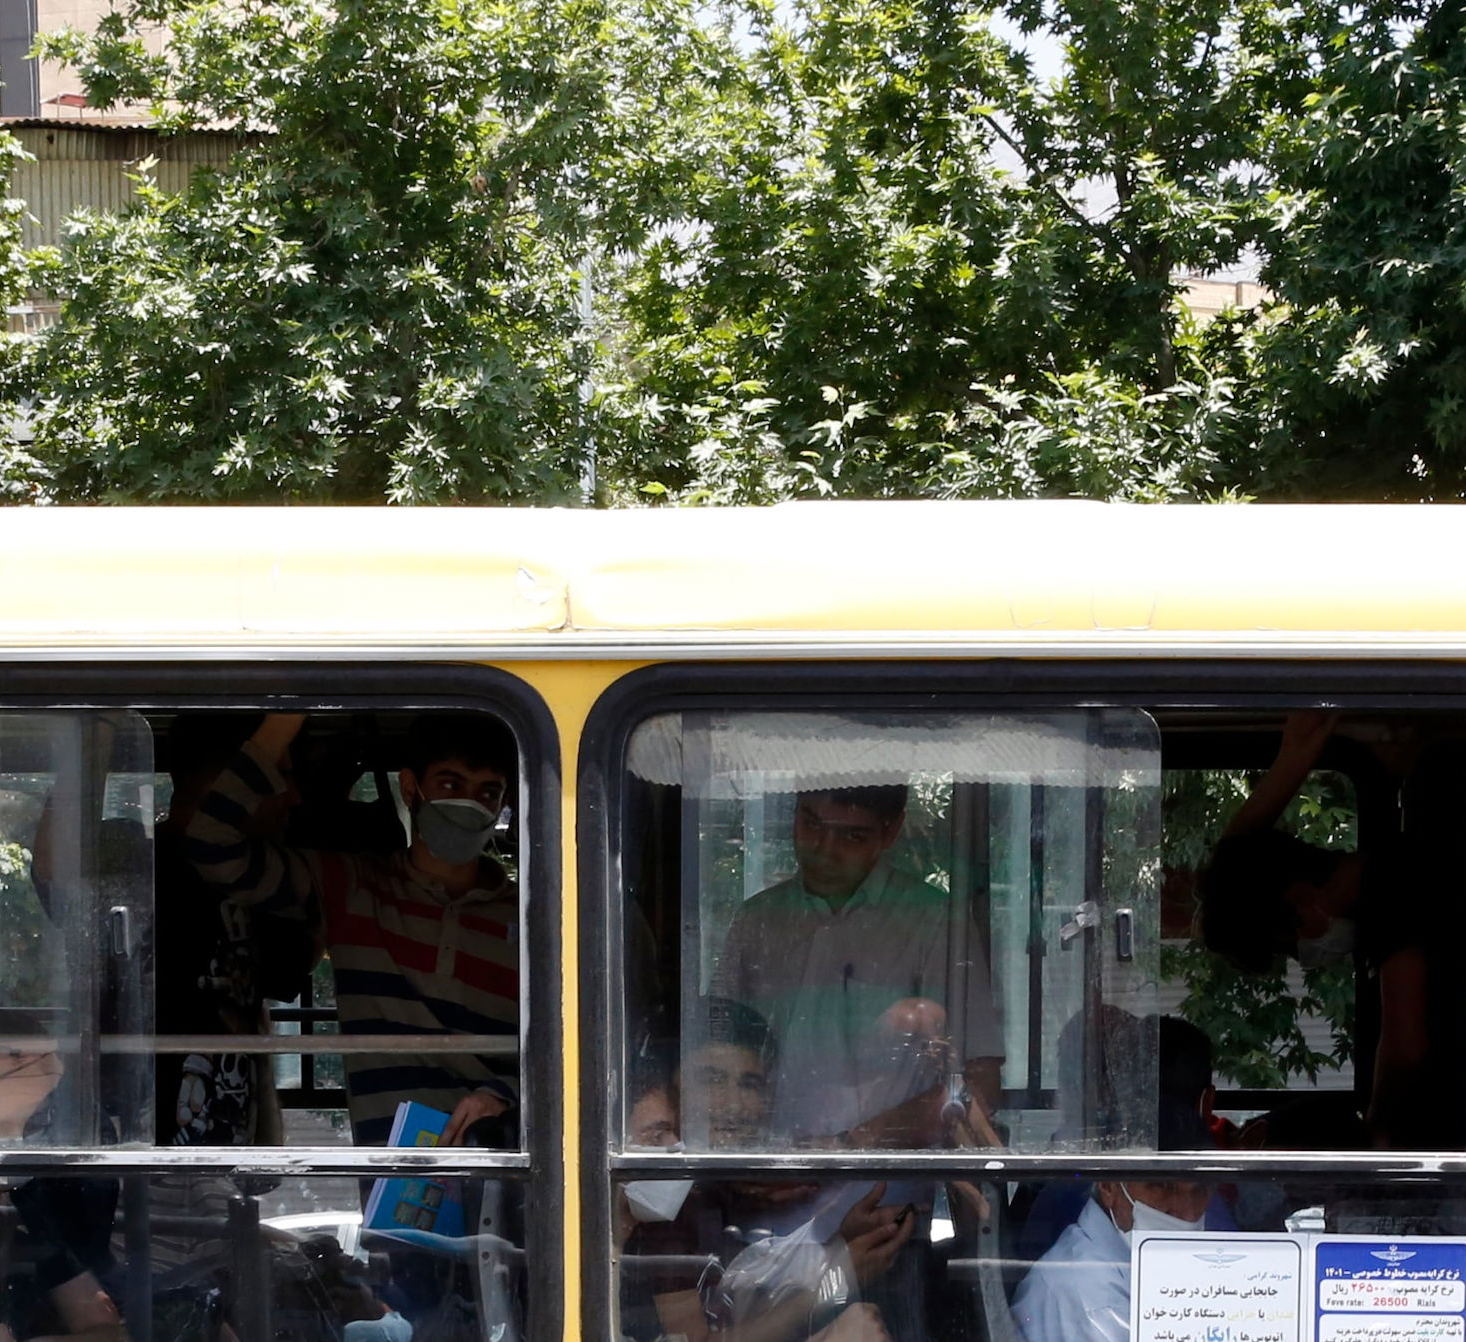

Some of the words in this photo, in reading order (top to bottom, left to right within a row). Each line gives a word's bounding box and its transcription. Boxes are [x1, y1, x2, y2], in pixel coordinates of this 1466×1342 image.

[1159, 1287, 1187, 1298] صورت
[1189, 1287, 1200, 1298] در
[1373, 1297, 1408, 1306] 26500
